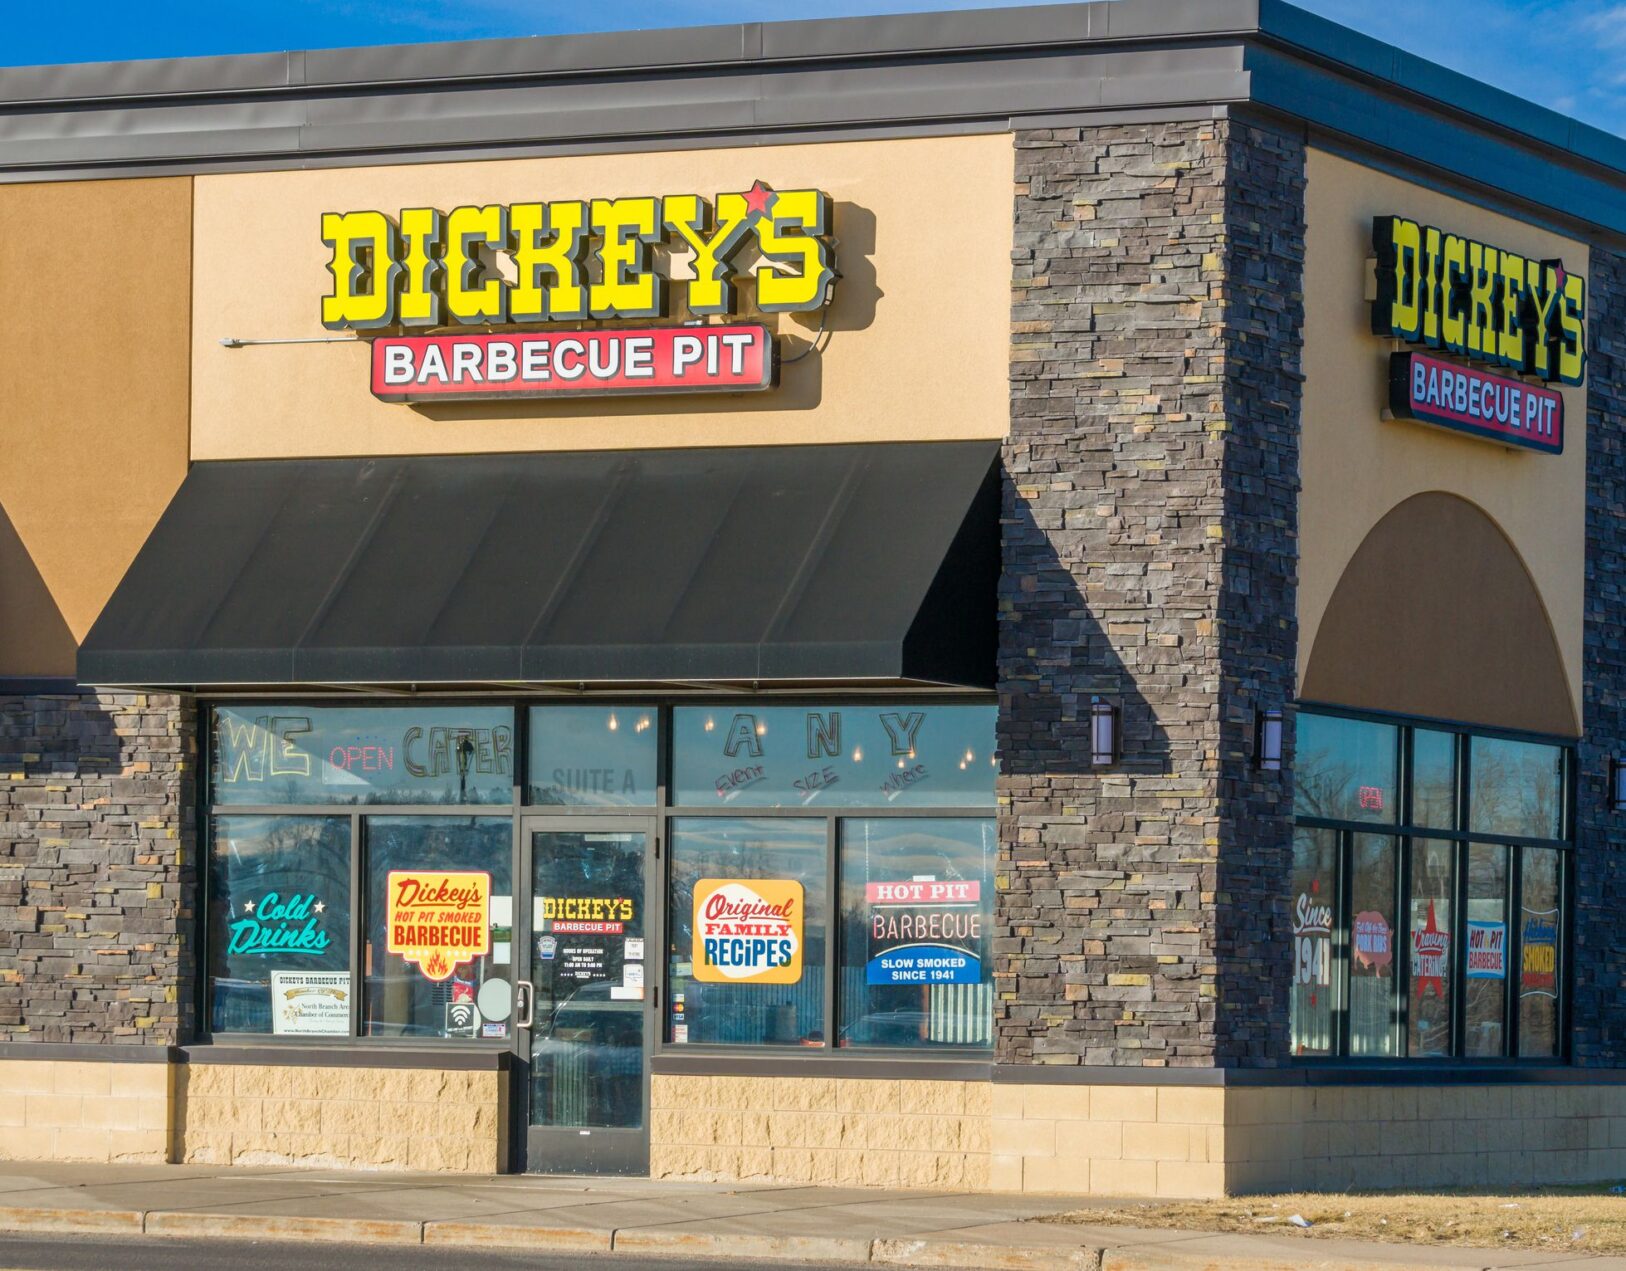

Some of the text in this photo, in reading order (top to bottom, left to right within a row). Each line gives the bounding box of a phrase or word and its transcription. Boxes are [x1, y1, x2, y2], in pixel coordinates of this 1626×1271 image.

[384, 334, 755, 385] BARBECUE PIT
[1413, 361, 1556, 435] BARBECUE PIT
[219, 715, 513, 782] WE CATER
[329, 746, 393, 770] OPEN
[552, 768, 636, 794] SUITE A
[793, 766, 840, 793] SIZE
[396, 878, 482, 909] Dickey's
[877, 884, 969, 899] HOT PIT
[257, 892, 315, 920] Cold
[395, 911, 482, 923] HOT PIT SMOKED
[705, 893, 794, 922] Original
[1294, 893, 1332, 934] Since
[228, 918, 330, 955] Drinks
[394, 926, 482, 947] BARBECUE
[554, 922, 620, 931] BARBECUE PIT
[705, 923, 792, 936] FAMILY
[873, 913, 981, 939] BARBECUE
[1414, 927, 1449, 954] Craving
[1469, 930, 1485, 948] HOT
[1490, 930, 1503, 949] PIT
[881, 958, 966, 968] SLOW SMOKED
[1294, 937, 1330, 985] 1941
[1468, 952, 1503, 970] BARBECUE
[1523, 945, 1555, 973] SMOKED
[892, 970, 954, 980] SINCE 1941
